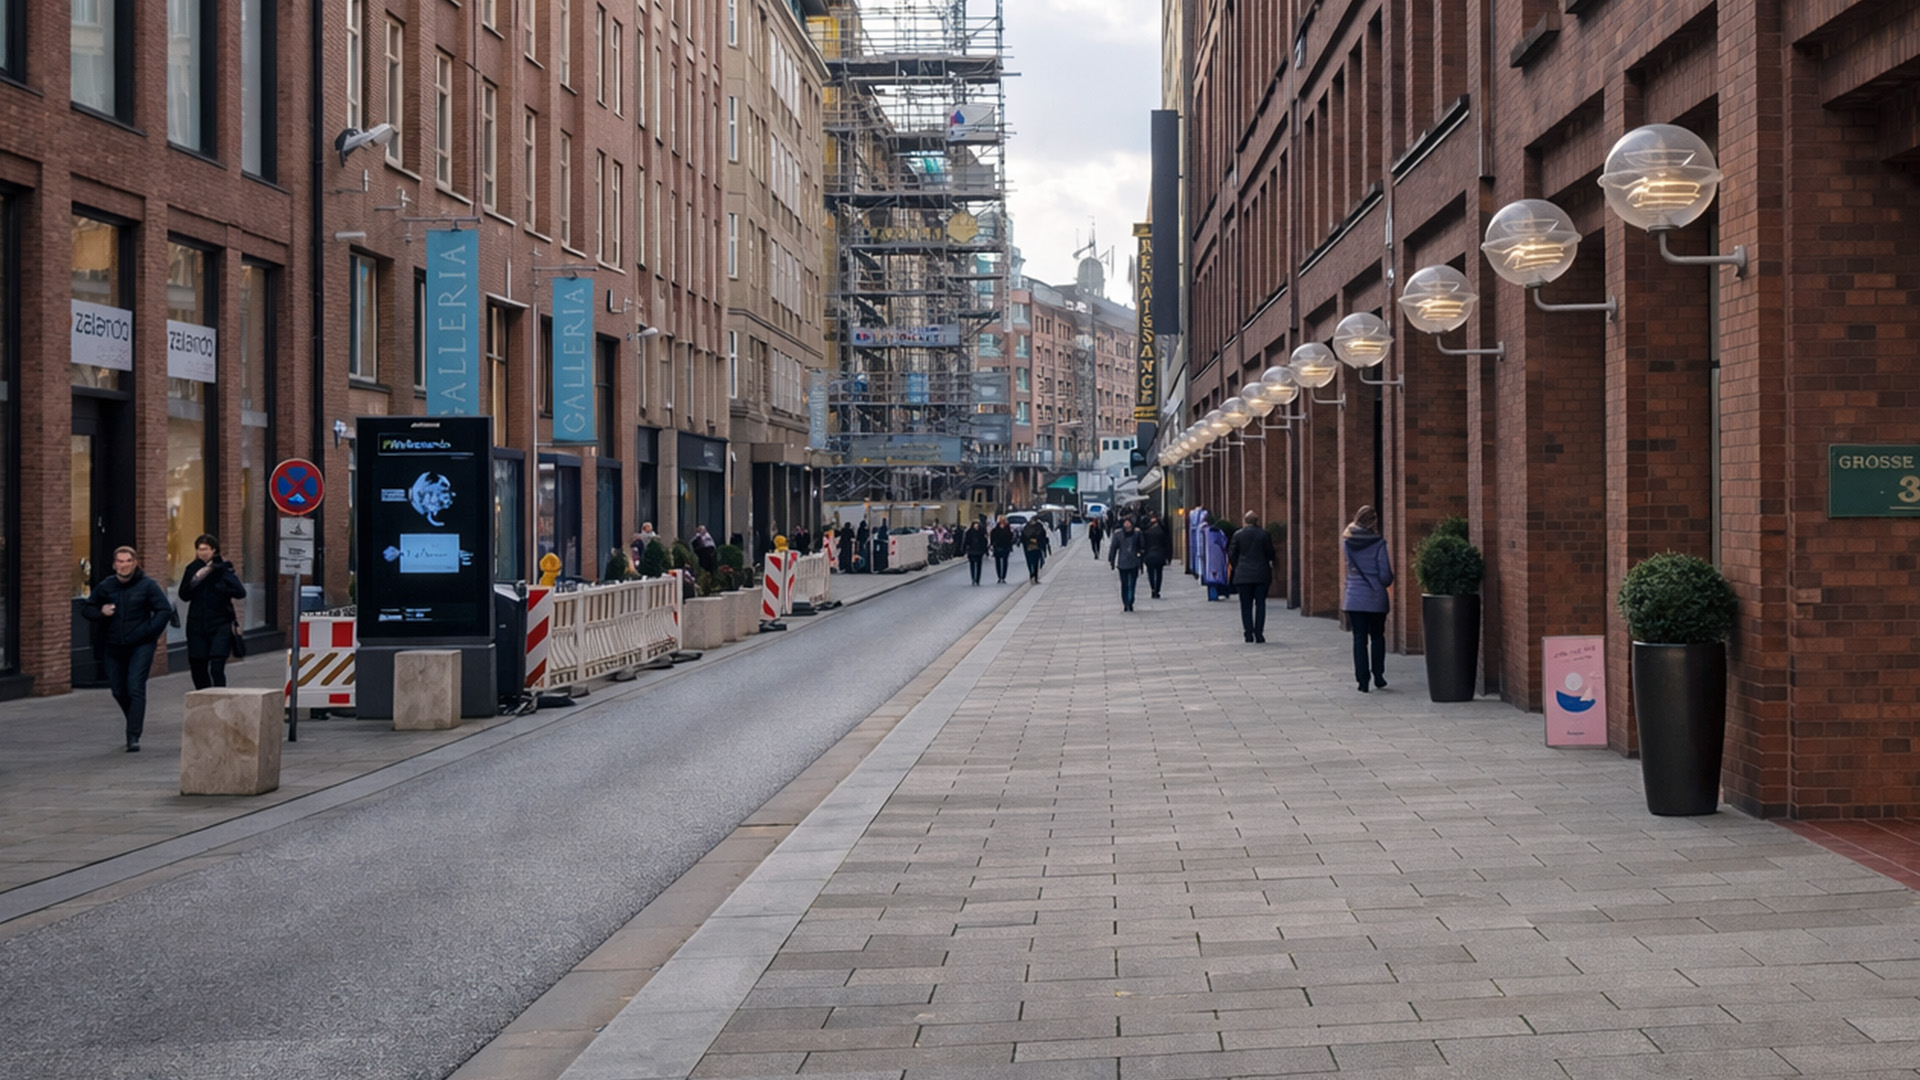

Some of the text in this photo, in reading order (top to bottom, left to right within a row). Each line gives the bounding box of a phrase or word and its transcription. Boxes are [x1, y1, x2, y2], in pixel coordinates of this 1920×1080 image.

[438, 244, 467, 415] ALLERIA
[562, 288, 585, 433] GALLERIA
[1141, 239, 1155, 403] RENAISSANCE
[1839, 455, 1915, 469] GROSSE
